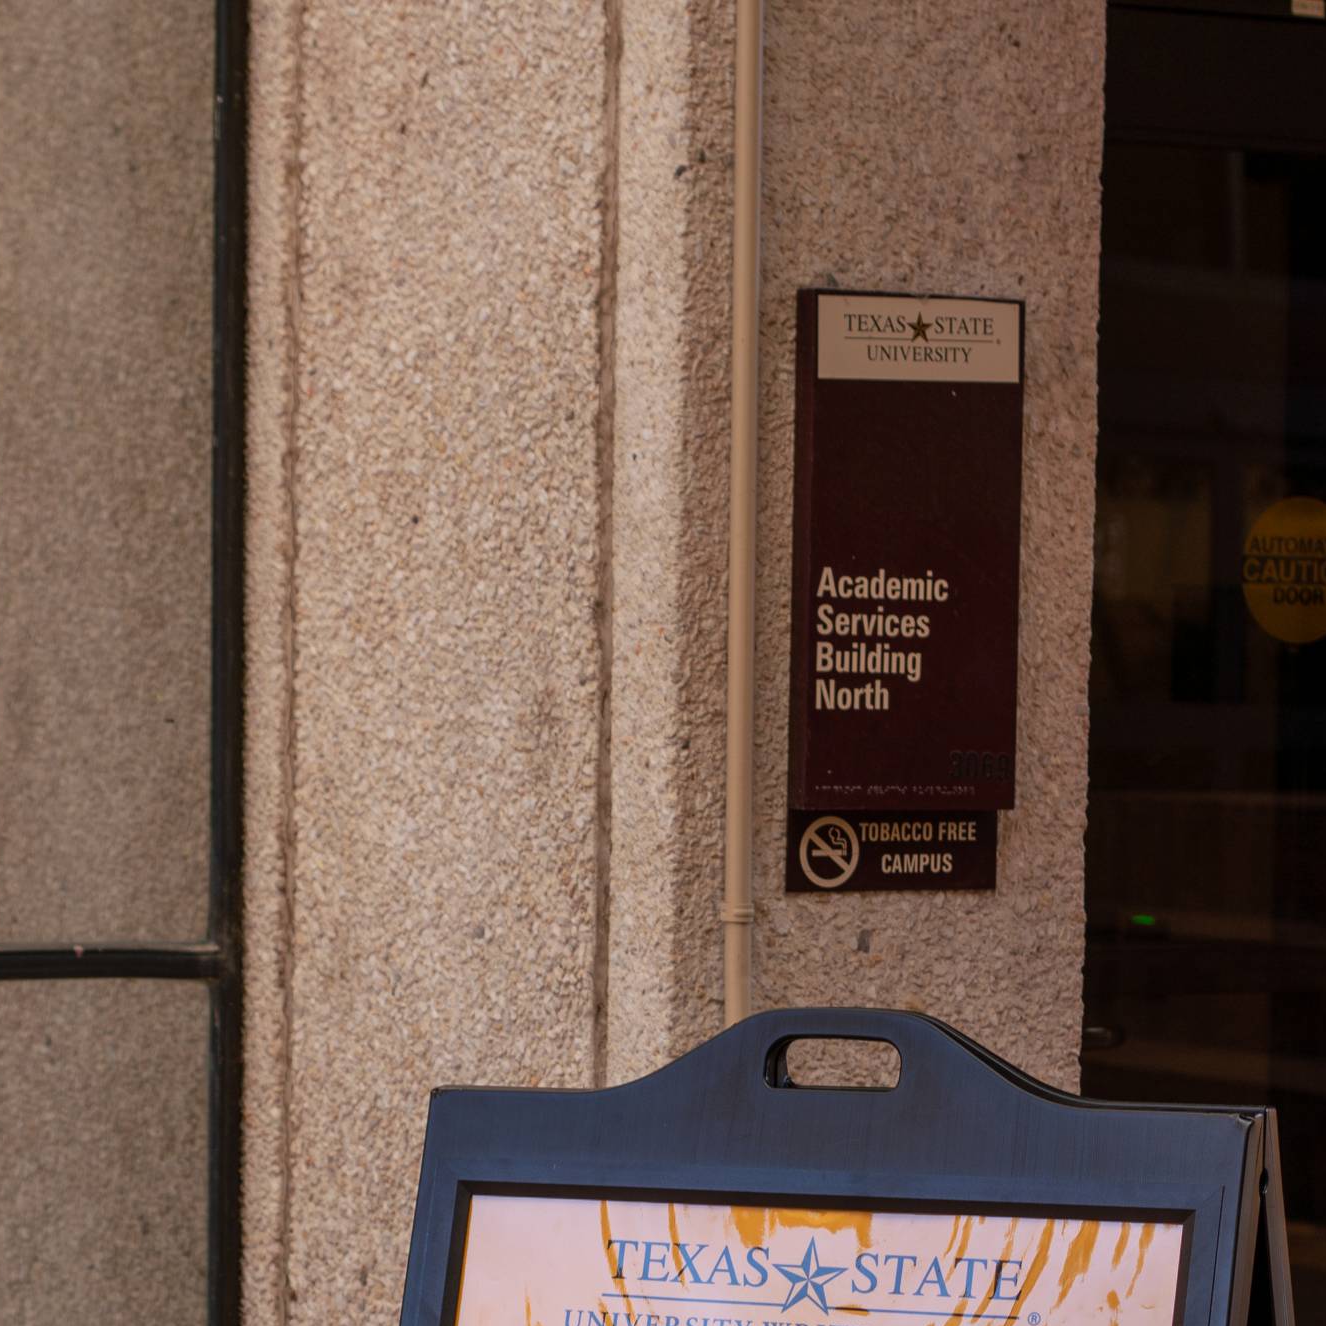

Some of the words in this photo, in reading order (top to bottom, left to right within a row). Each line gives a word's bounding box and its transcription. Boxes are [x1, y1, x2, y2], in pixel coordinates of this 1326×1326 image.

[844, 313, 906, 334] TEXAS
[934, 316, 994, 336] STATE
[866, 345, 972, 363] UNIVERSITY
[817, 567, 949, 601] Academic
[1273, 587, 1325, 606] DOOR
[816, 604, 930, 638] Services
[815, 641, 922, 682] Building
[815, 679, 889, 711] North
[859, 822, 933, 842] TOBACCO
[938, 822, 977, 841] FREE
[881, 854, 953, 874] CAMPUS
[606, 1239, 771, 1289] TEXAS
[851, 1252, 1024, 1301] STATE
